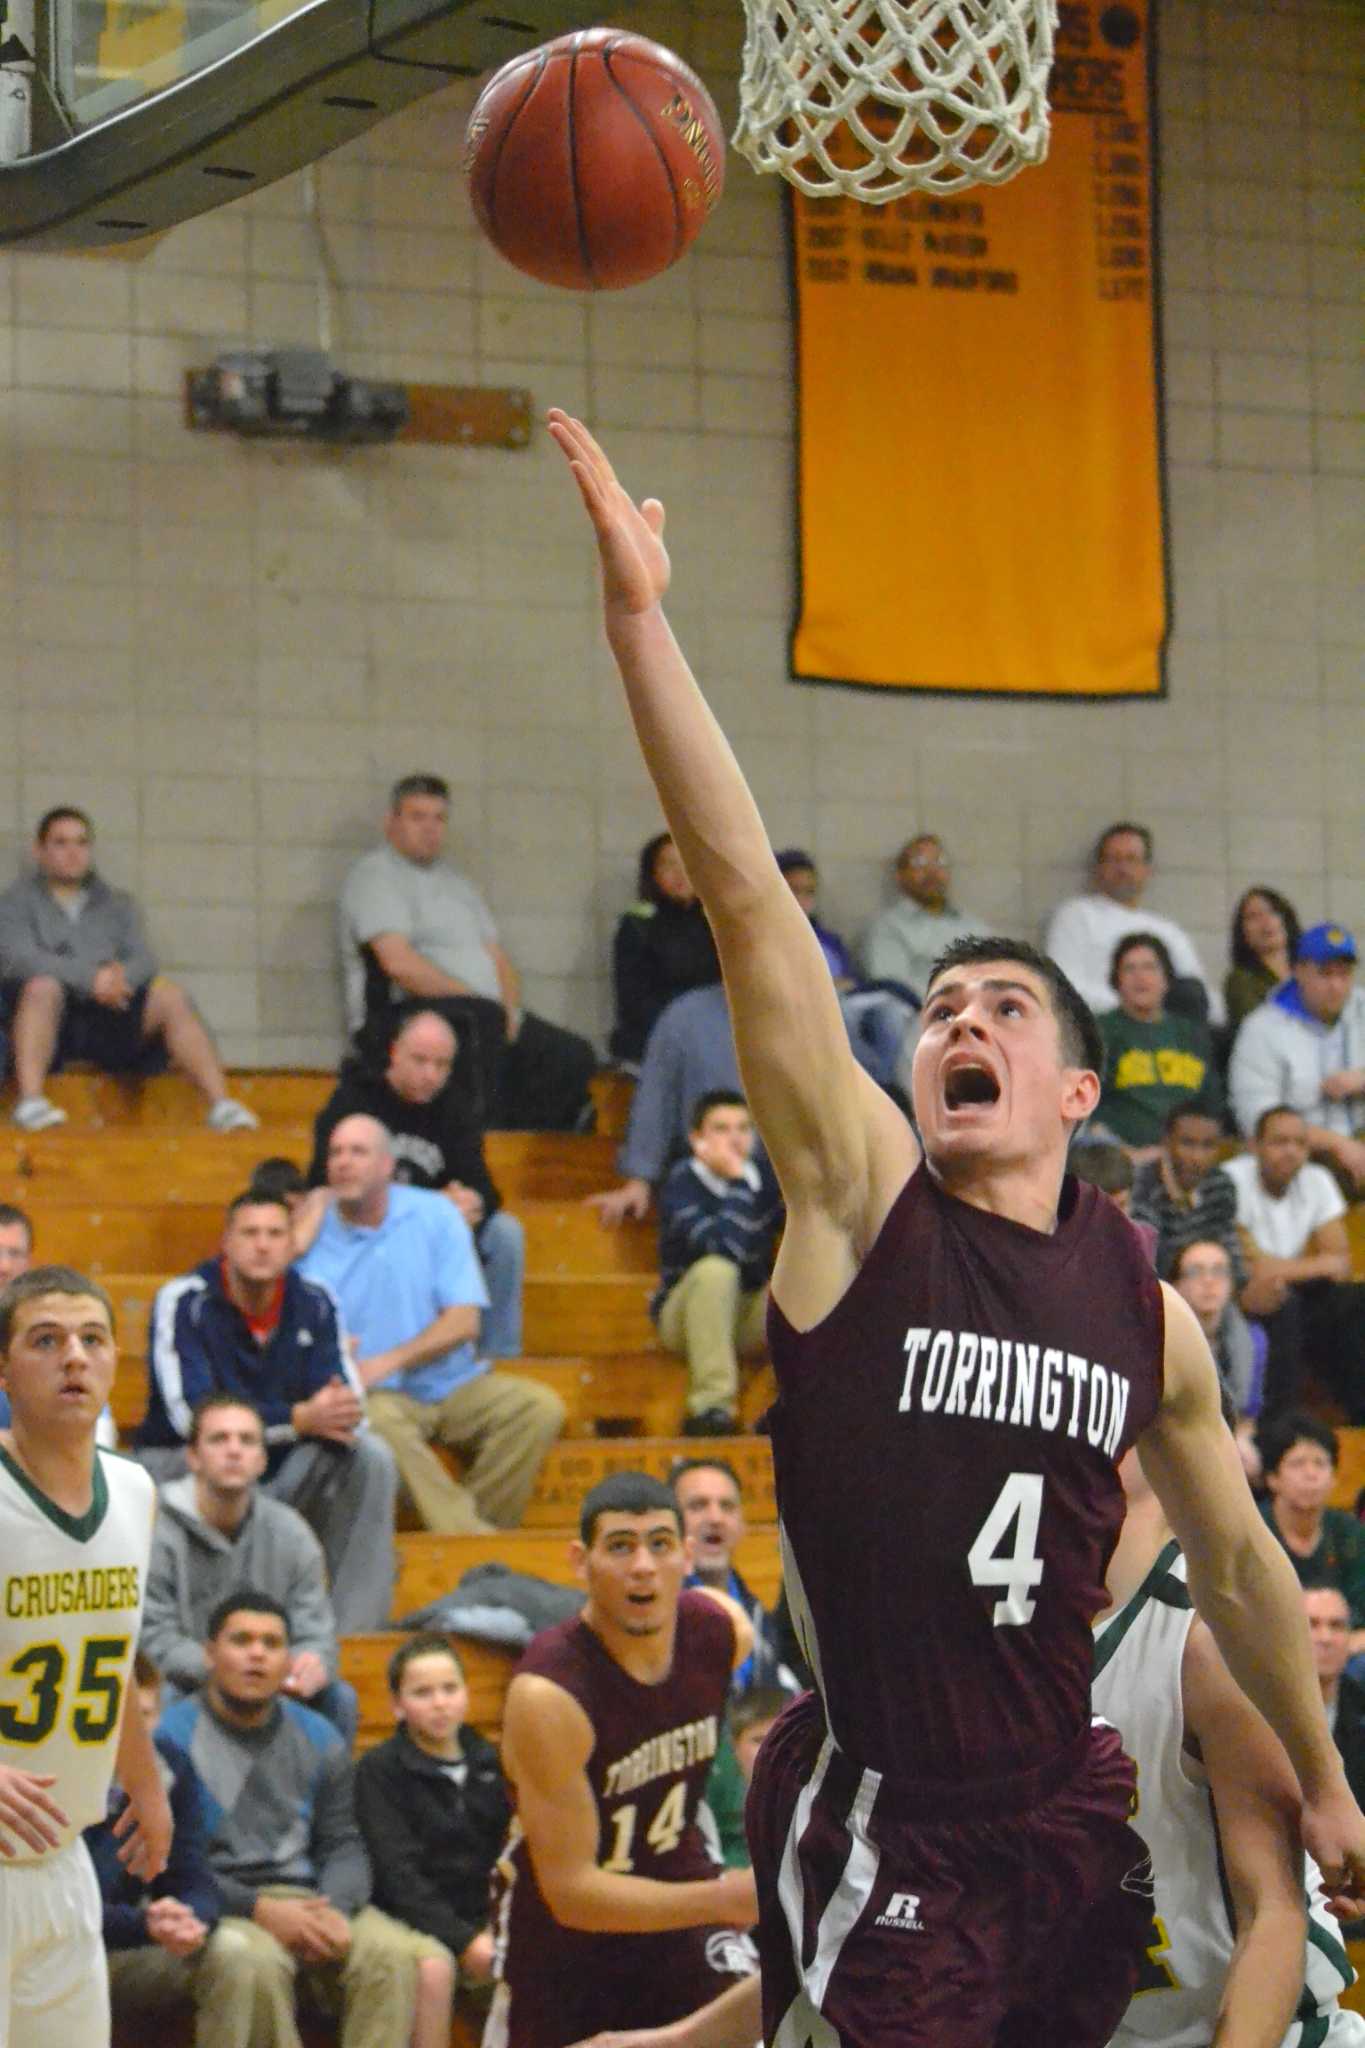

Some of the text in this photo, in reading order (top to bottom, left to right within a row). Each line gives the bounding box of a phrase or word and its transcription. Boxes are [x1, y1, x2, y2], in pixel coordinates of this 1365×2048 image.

[899, 1328, 1129, 1459] TORRINGTON
[6, 1566, 139, 1619] CRUSADERS
[967, 1472, 1044, 1627] 4
[0, 1633, 131, 1748] 35
[603, 1715, 718, 1799] TORRINGTON
[603, 1781, 688, 1872] 14
